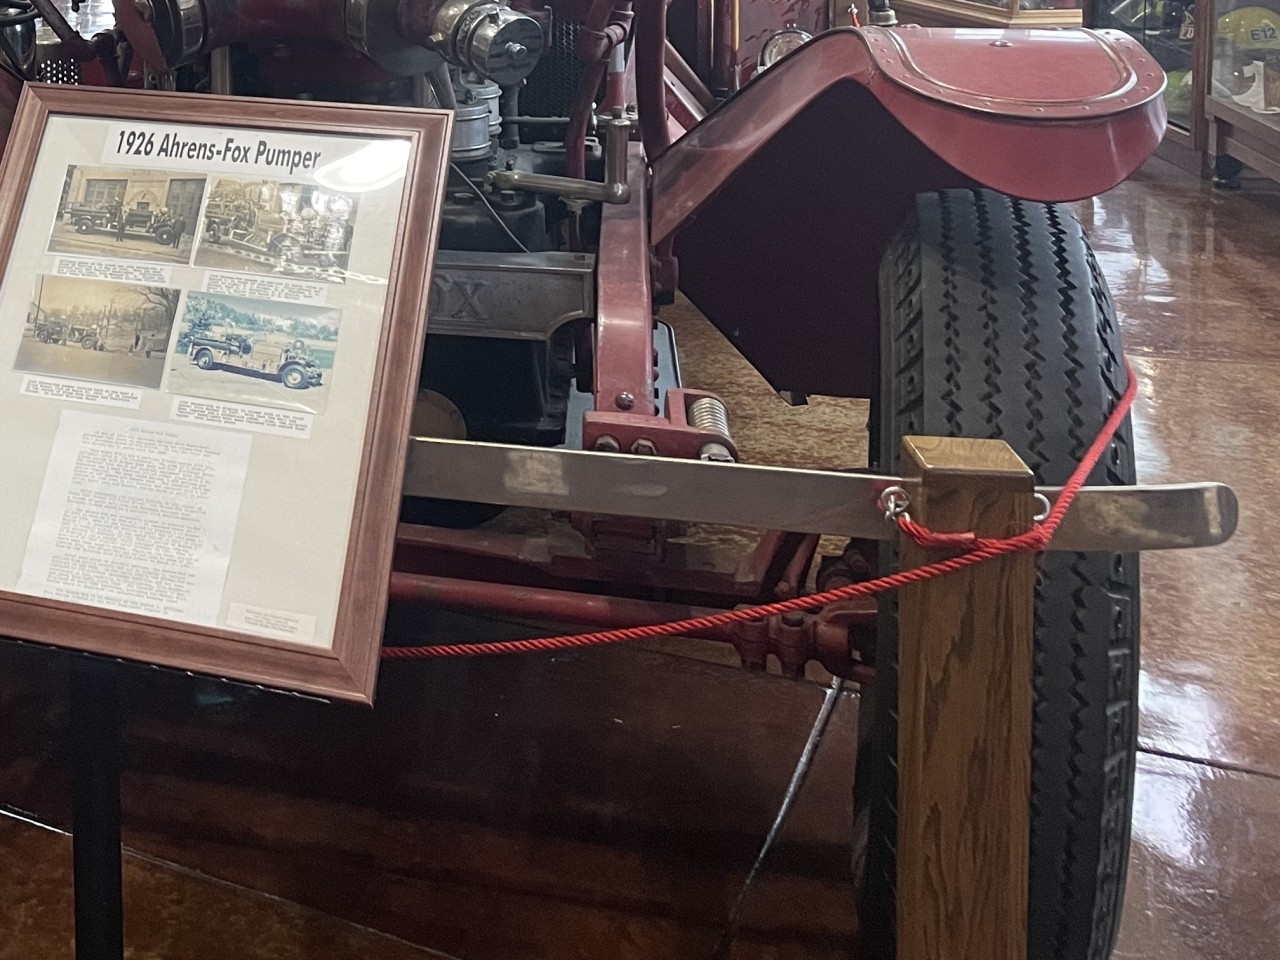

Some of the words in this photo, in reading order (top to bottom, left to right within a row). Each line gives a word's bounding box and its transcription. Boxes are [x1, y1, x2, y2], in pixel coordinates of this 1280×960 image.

[1250, 27, 1277, 41] E12
[116, 130, 155, 156] 1926
[157, 132, 251, 163] Ahrens-Fox
[254, 140, 322, 174] Pumper
